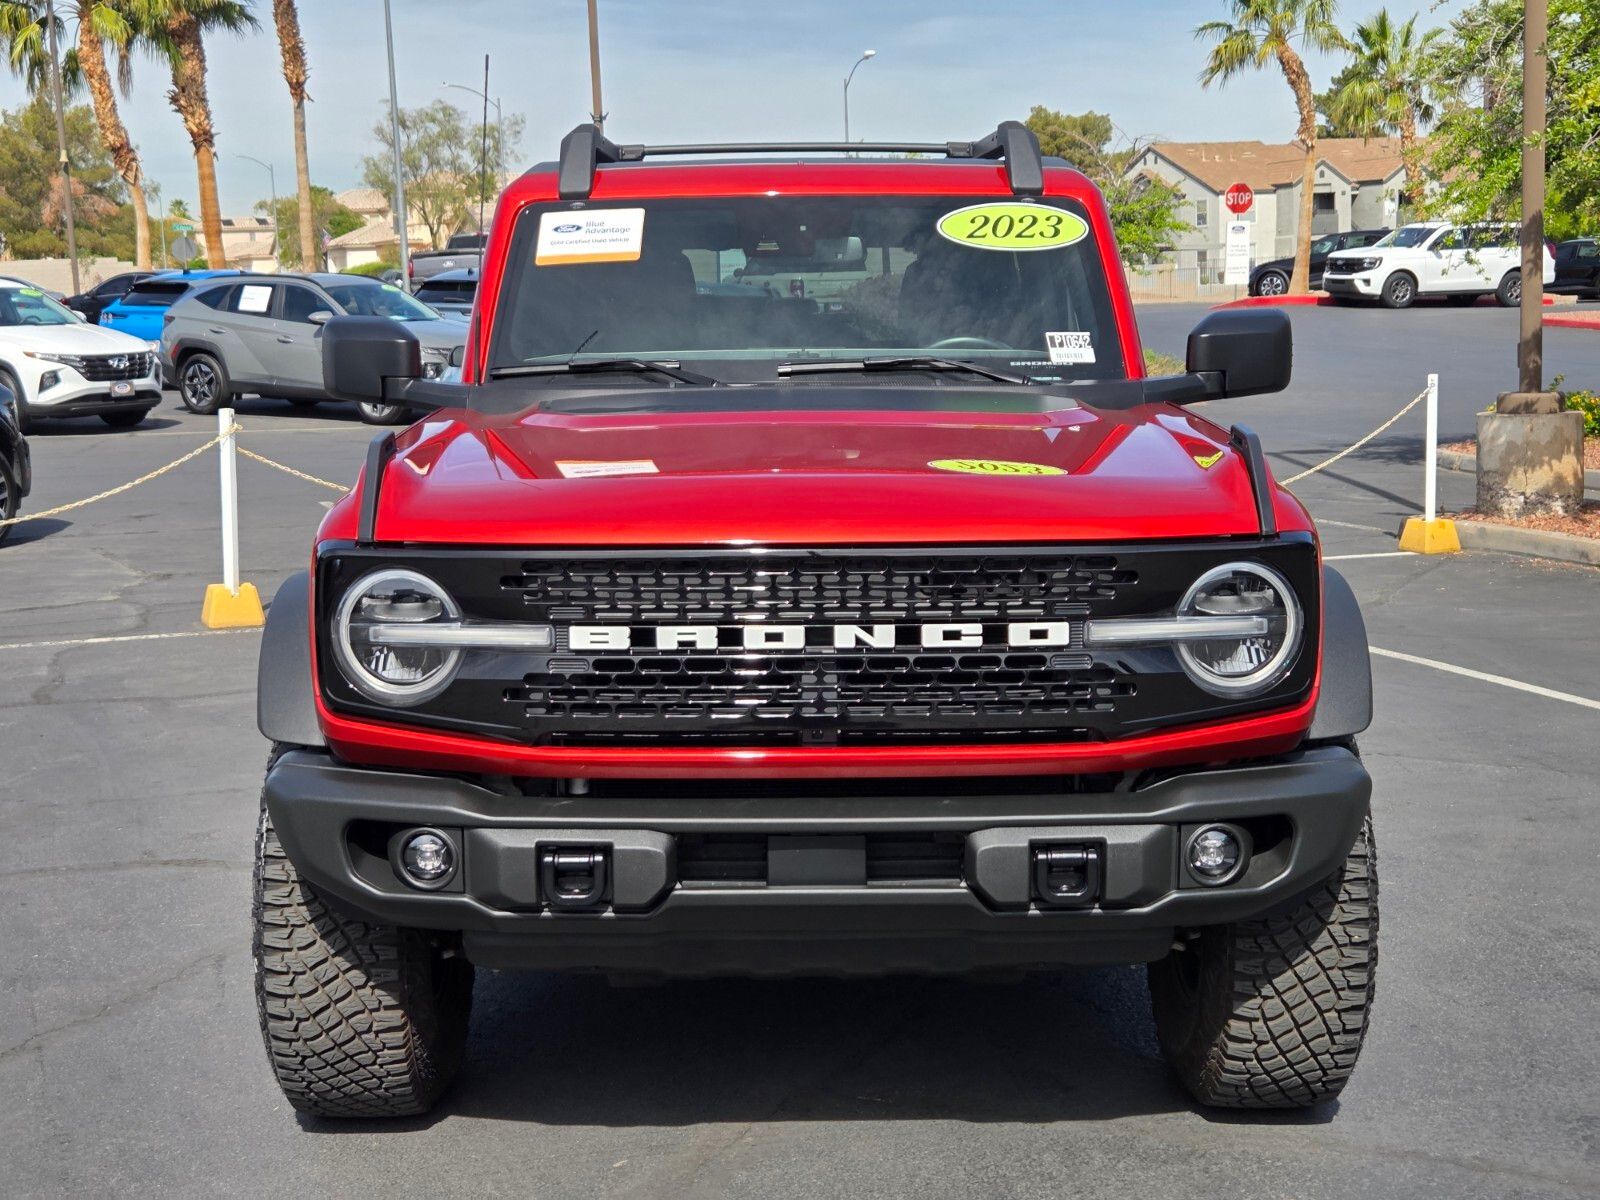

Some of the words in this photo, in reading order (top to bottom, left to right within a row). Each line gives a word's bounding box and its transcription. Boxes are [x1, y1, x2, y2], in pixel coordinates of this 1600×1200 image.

[1227, 192, 1251, 205] STOP
[585, 226, 631, 235] Advantage
[586, 220, 605, 228] Blue
[966, 214, 1064, 239] 2023
[568, 620, 1070, 650] BRONCO
